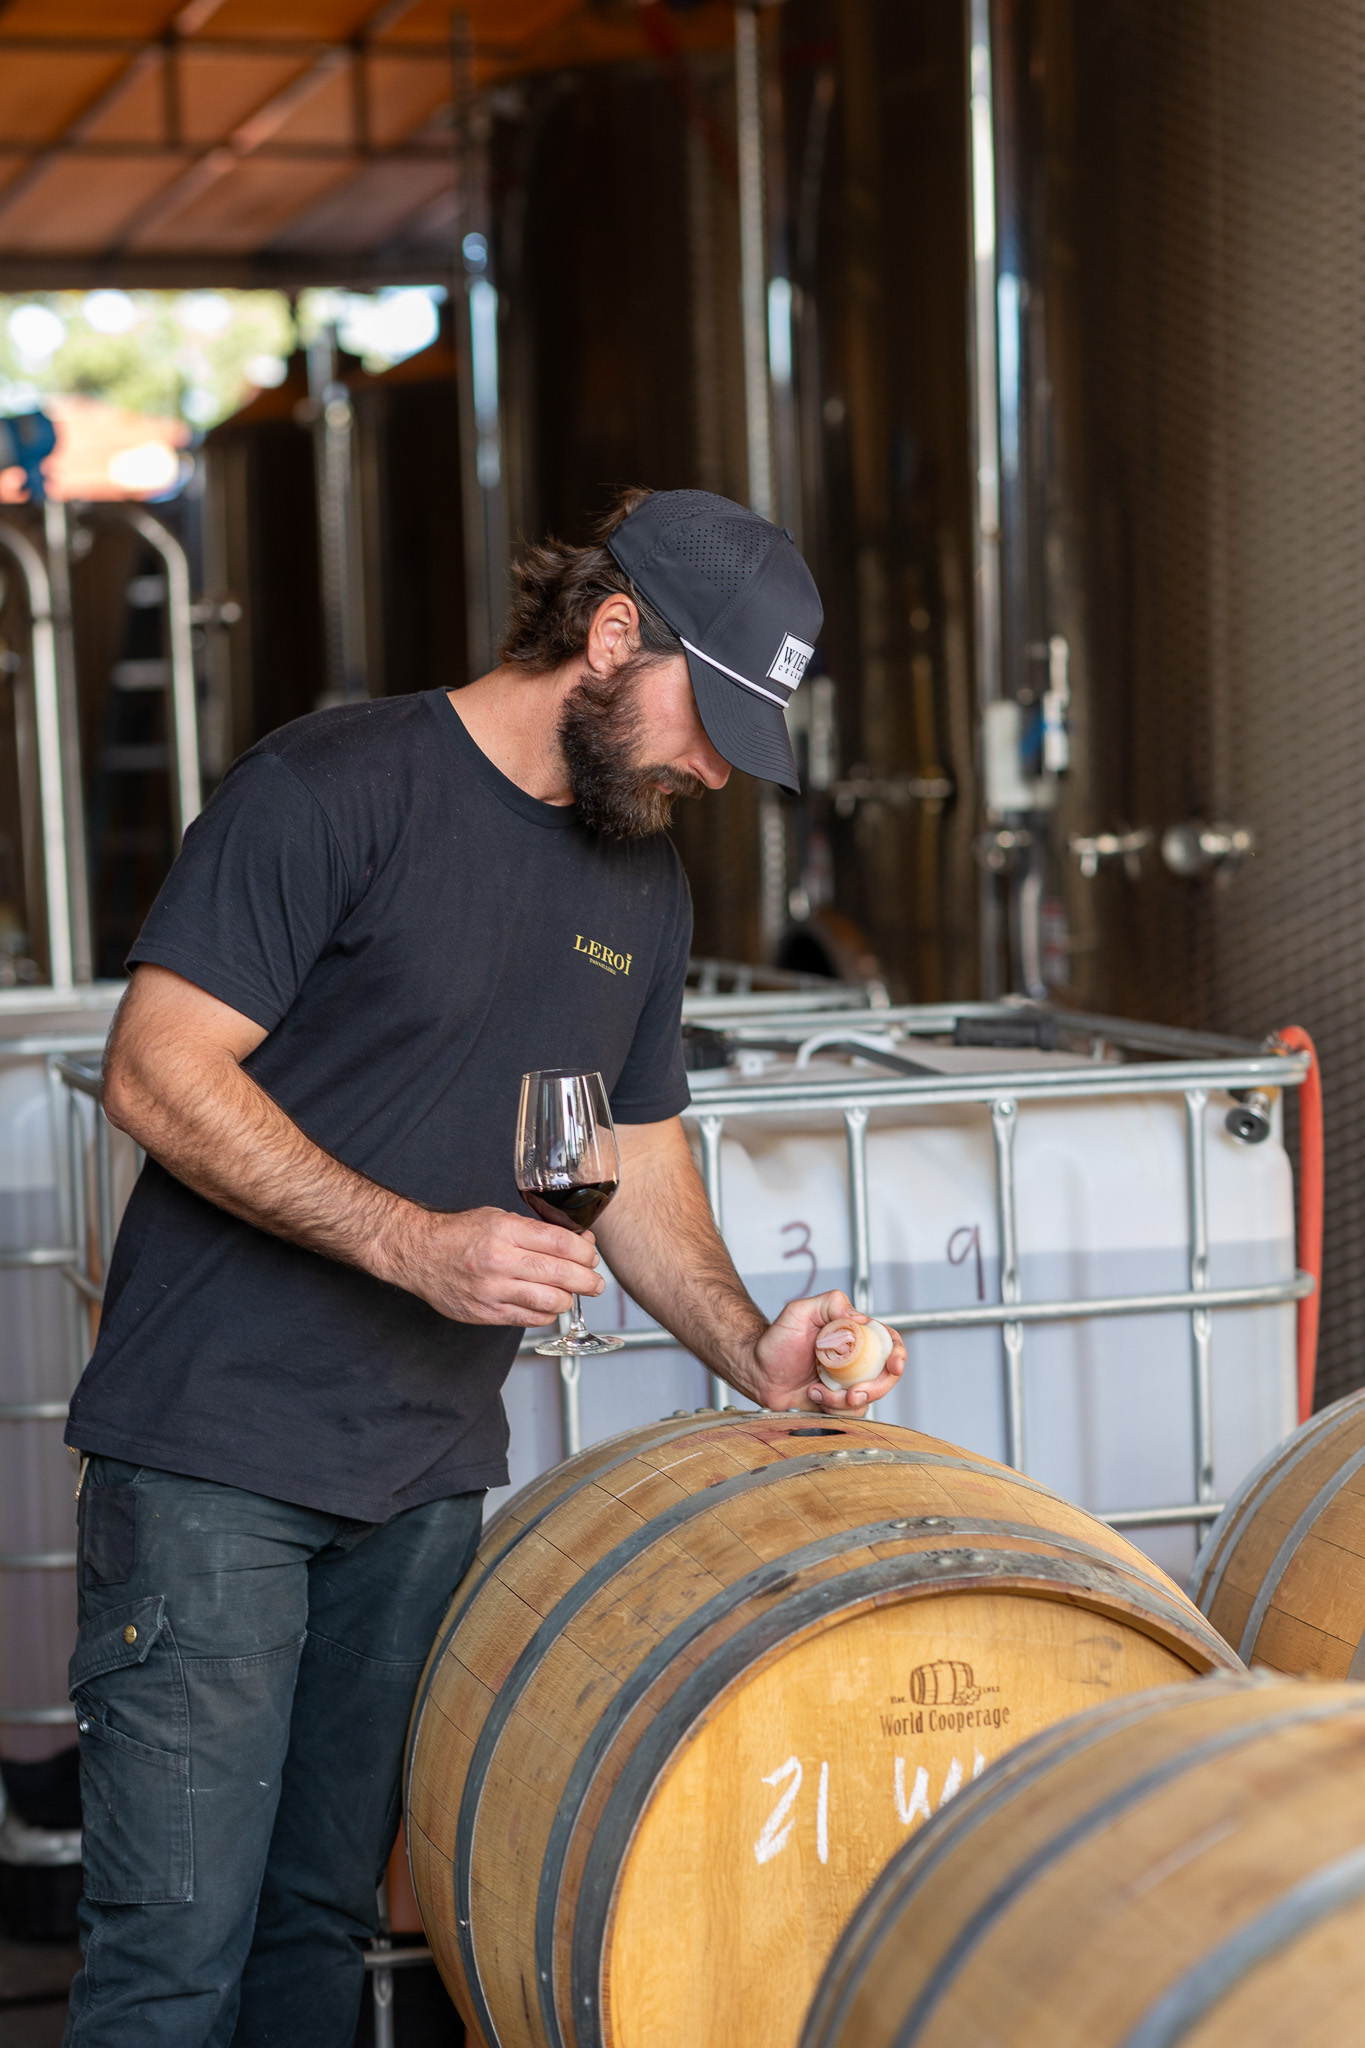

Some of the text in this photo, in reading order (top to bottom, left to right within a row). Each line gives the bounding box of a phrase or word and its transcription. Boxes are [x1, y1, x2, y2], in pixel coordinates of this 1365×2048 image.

[879, 1706, 1010, 1738] World Cooperage
[754, 1755, 829, 1865] 21
